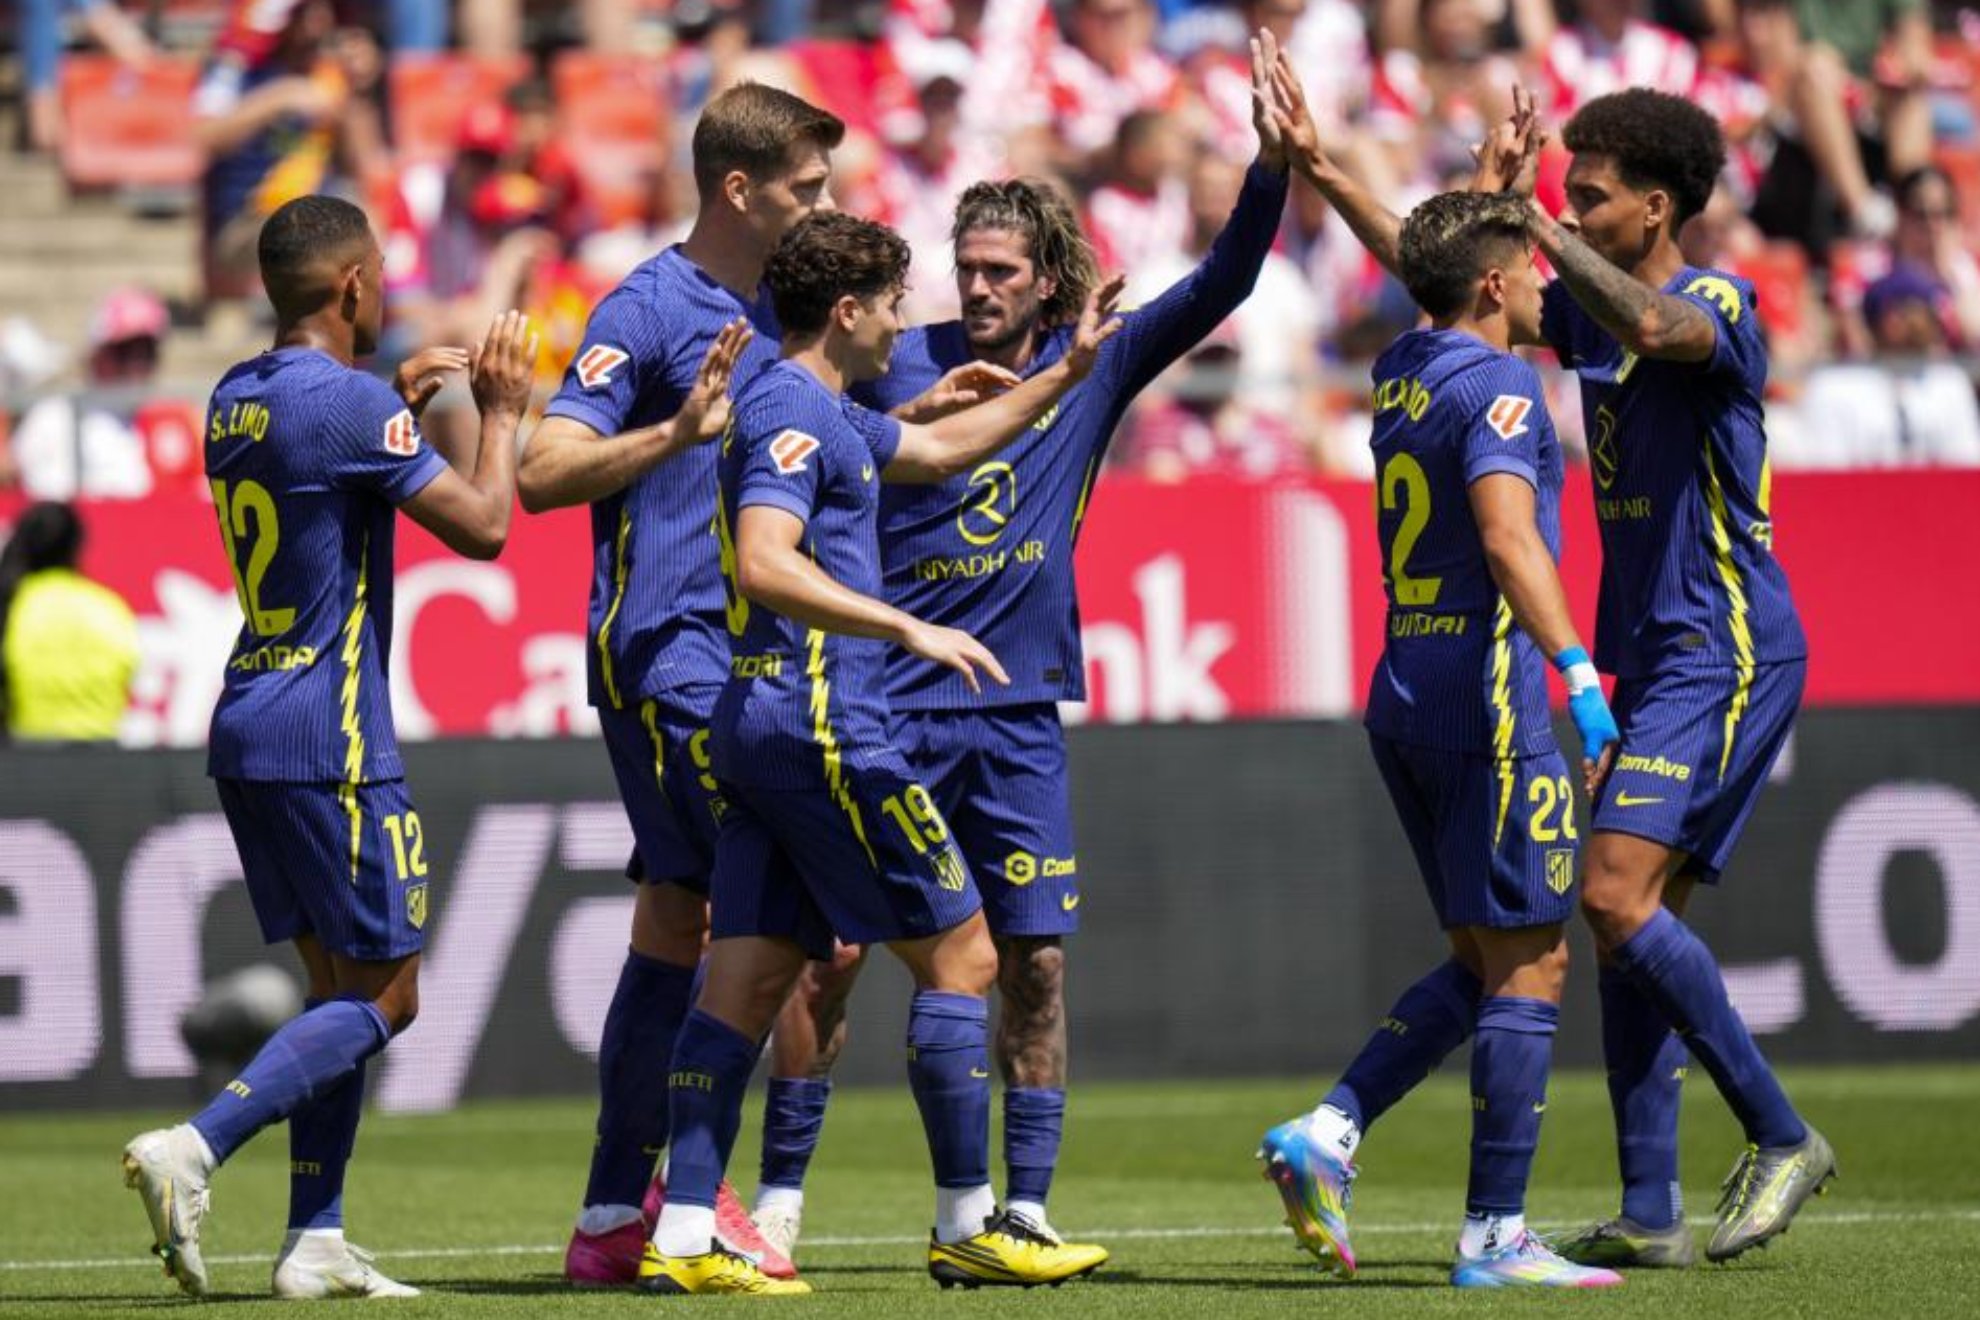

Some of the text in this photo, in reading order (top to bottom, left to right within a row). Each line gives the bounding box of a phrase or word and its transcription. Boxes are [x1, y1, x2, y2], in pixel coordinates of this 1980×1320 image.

[1381, 451, 1443, 605] 2
[881, 783, 948, 854] 19
[1528, 775, 1578, 842] 22
[383, 810, 428, 880] 12
